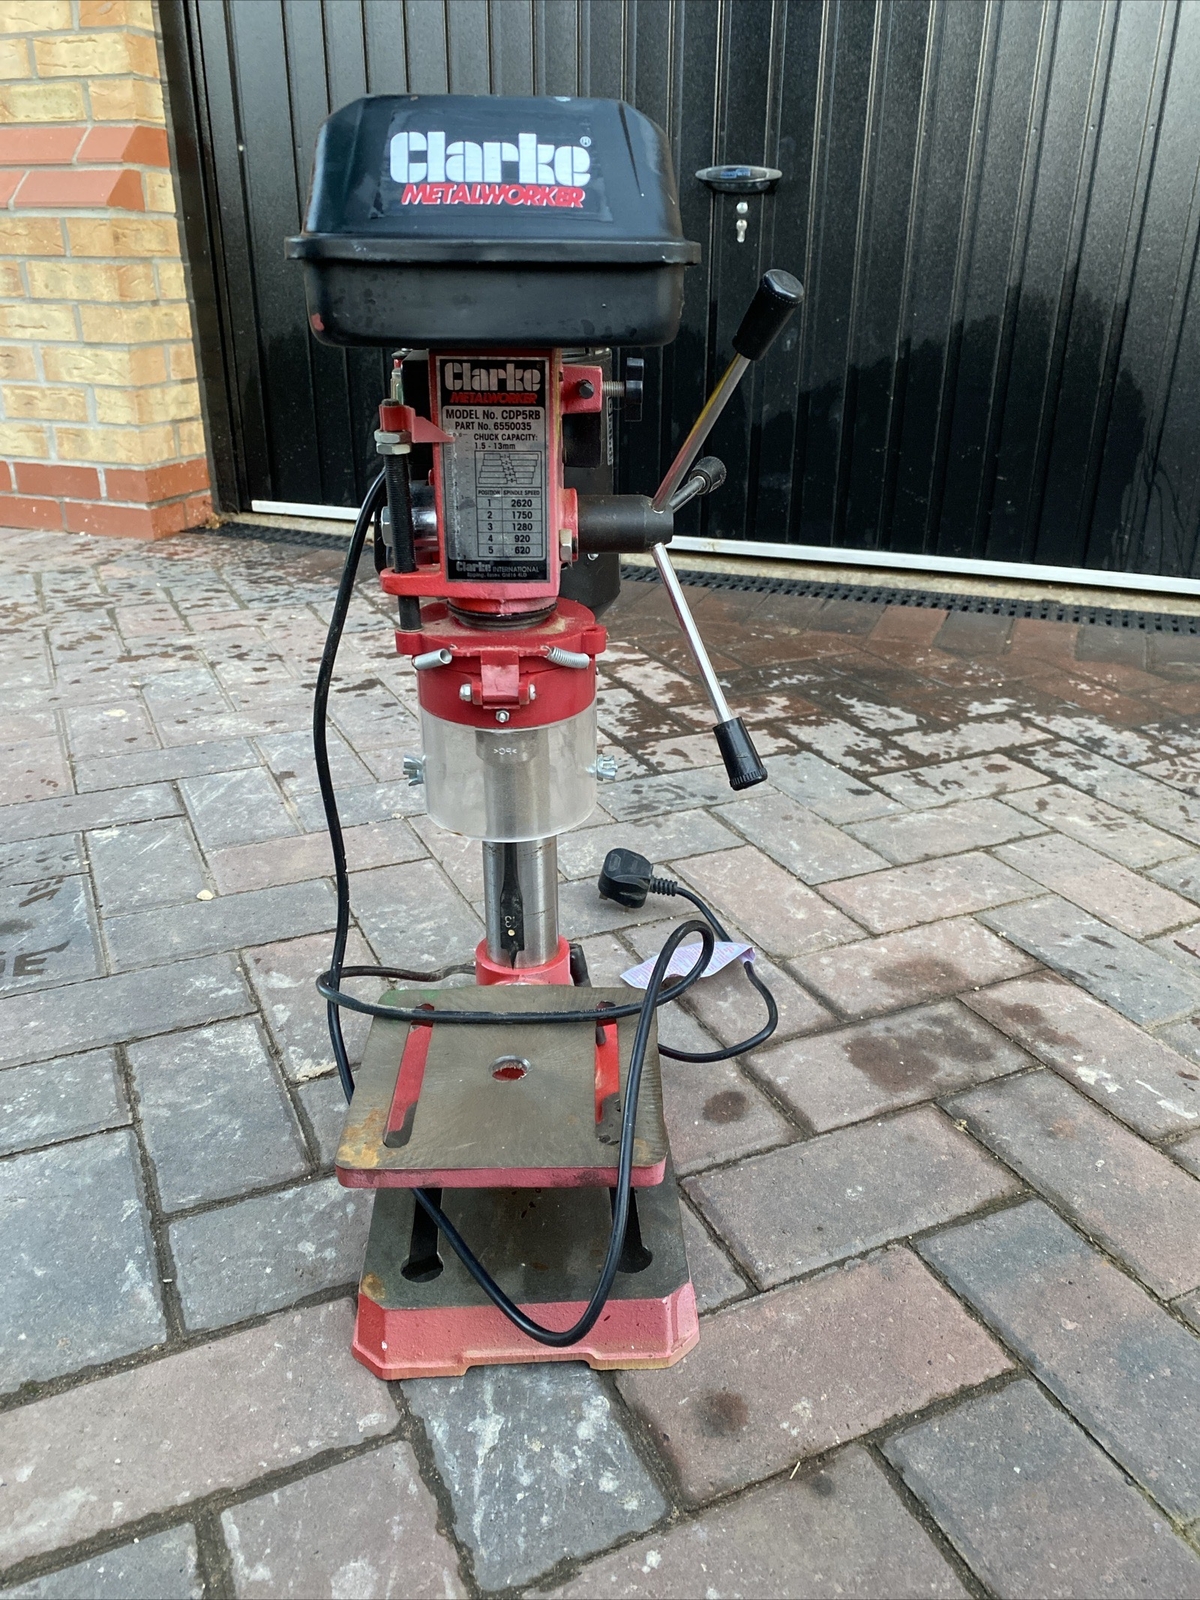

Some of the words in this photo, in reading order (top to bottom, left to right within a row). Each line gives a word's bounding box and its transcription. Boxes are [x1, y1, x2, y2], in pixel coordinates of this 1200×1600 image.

[390, 131, 590, 187] Clarke
[401, 183, 585, 208] METALWORKER
[444, 362, 541, 391] Clarke
[449, 391, 538, 405] METALWORKER
[445, 409, 479, 419] MODEL
[482, 410, 498, 420] No.
[501, 410, 541, 420] CDP5RB
[455, 422, 475, 430] PART
[477, 422, 491, 431] No.
[493, 422, 532, 431] 6550035
[473, 433, 499, 441] CHUCK
[501, 433, 538, 441] CAPACITY:
[493, 442, 516, 450] 13mm
[487, 499, 491, 507] 1
[511, 499, 533, 508] 2620
[487, 511, 493, 519] 2
[512, 511, 533, 519] 1750
[487, 523, 493, 531] 3
[512, 523, 533, 531] 1280
[488, 535, 493, 543] 4
[514, 535, 531, 543] 920
[514, 546, 531, 555] 620
